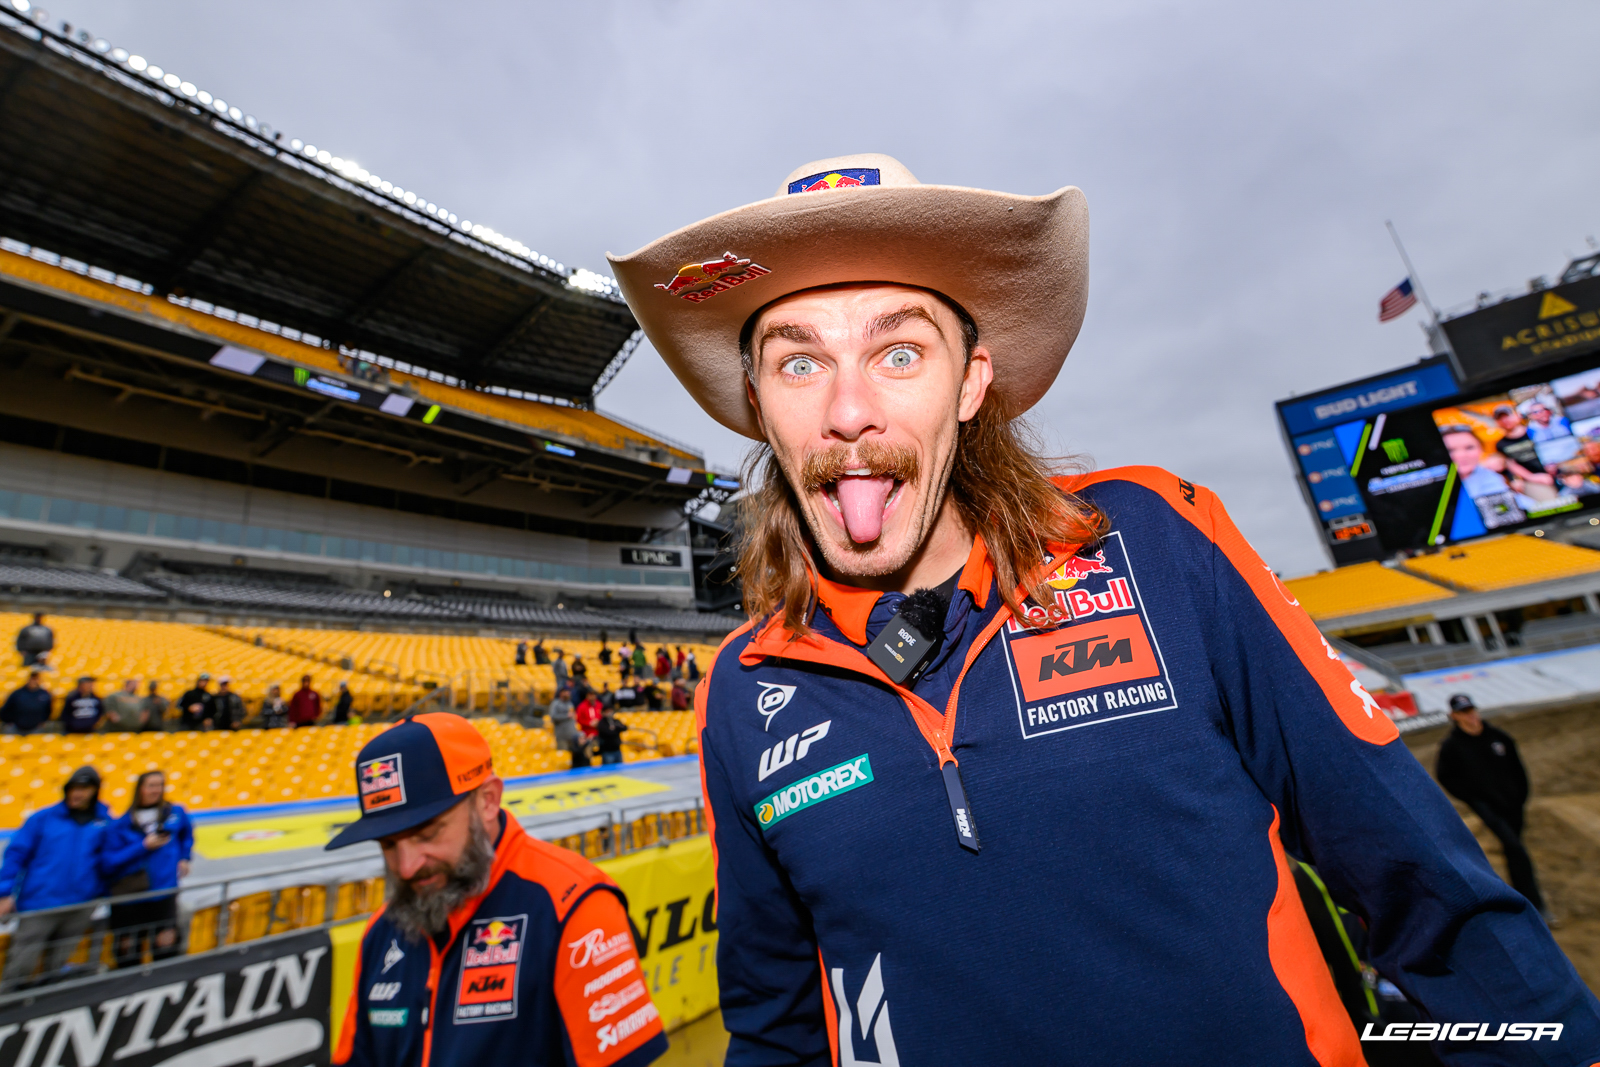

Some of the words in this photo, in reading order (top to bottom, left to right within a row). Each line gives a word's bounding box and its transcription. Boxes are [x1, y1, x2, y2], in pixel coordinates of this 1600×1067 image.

[1314, 398, 1358, 420] BUD
[1358, 381, 1418, 409] LIGHT
[1066, 577, 1135, 619] Bull
[1038, 634, 1134, 683] KTM
[1027, 694, 1099, 726] FACTORY
[1104, 682, 1168, 710] RACING
[758, 720, 831, 782] WP
[956, 808, 972, 838] KTM
[468, 974, 507, 995] KTM
